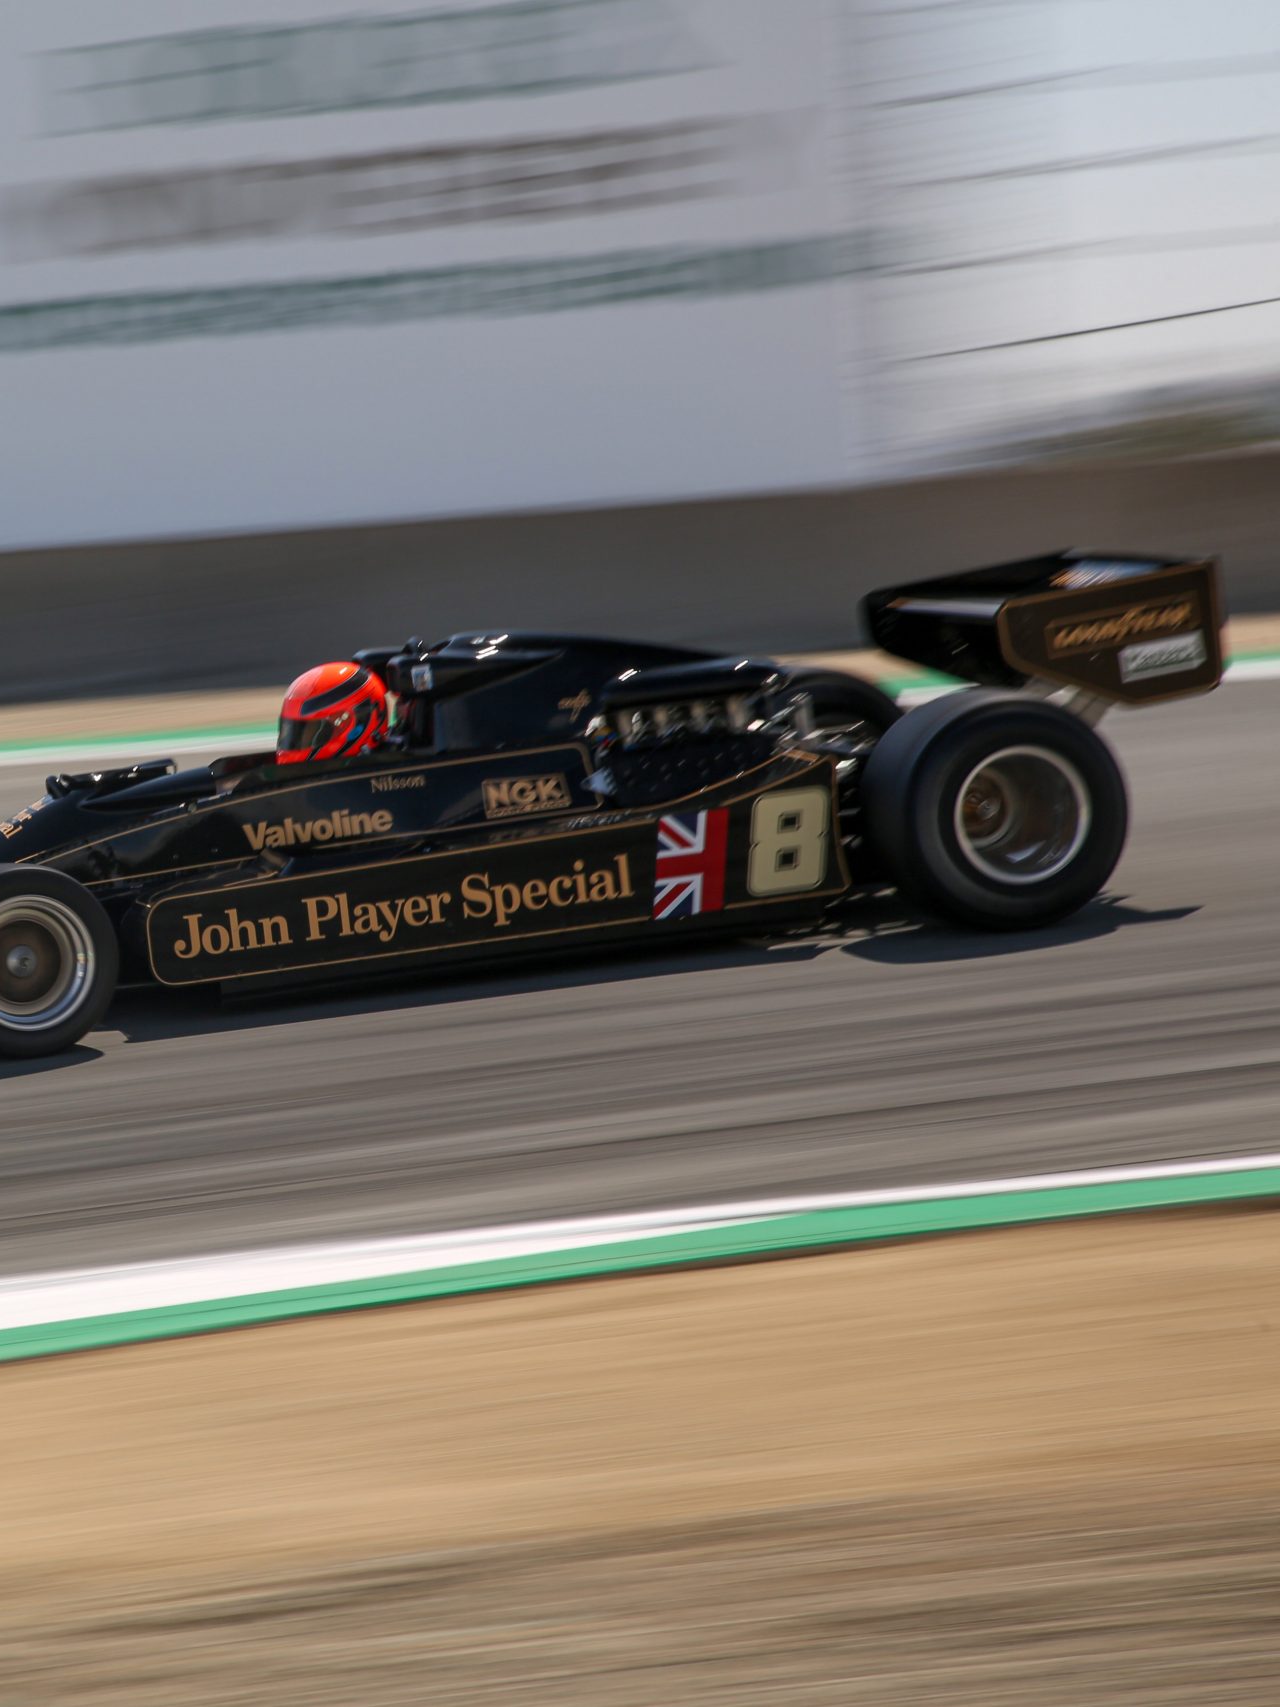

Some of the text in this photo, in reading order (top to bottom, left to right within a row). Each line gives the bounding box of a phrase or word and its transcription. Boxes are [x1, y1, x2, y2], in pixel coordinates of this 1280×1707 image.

[371, 774, 426, 793] Nilsson
[486, 776, 563, 810] NGK
[242, 808, 393, 850] Valvoline
[747, 785, 830, 897] 8
[174, 852, 635, 959] John Player Special
